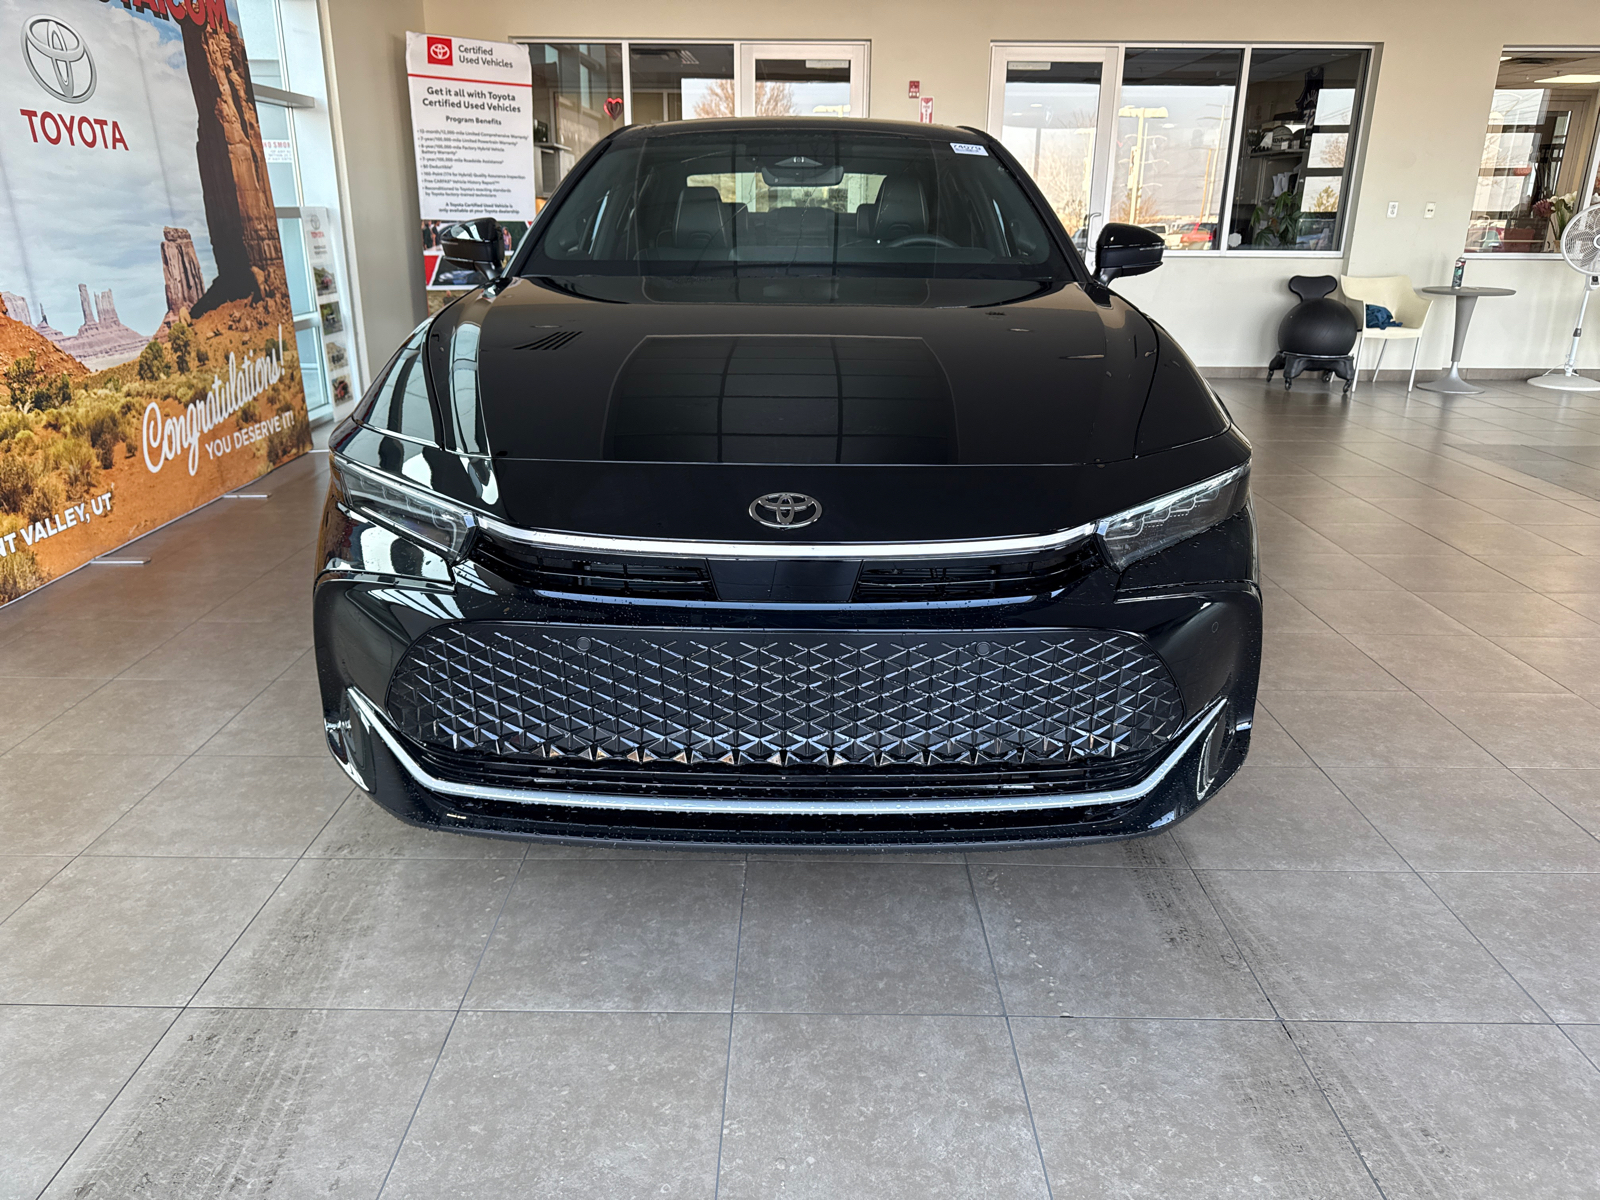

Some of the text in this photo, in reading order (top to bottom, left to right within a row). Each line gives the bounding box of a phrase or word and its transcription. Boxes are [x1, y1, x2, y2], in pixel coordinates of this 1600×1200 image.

[458, 44, 493, 56] Certified
[459, 55, 513, 68] Used Vehicles
[427, 86, 516, 102] Get it all with Toyota
[422, 98, 521, 113] Certified Used Vehicles
[445, 115, 502, 125] Program Benefits
[19, 108, 129, 151] TOYOTA
[143, 323, 285, 476] Congratulations!
[205, 410, 295, 459] YOU DESERVE IT!
[20, 502, 90, 546] VALLEY,
[91, 492, 111, 515] UT
